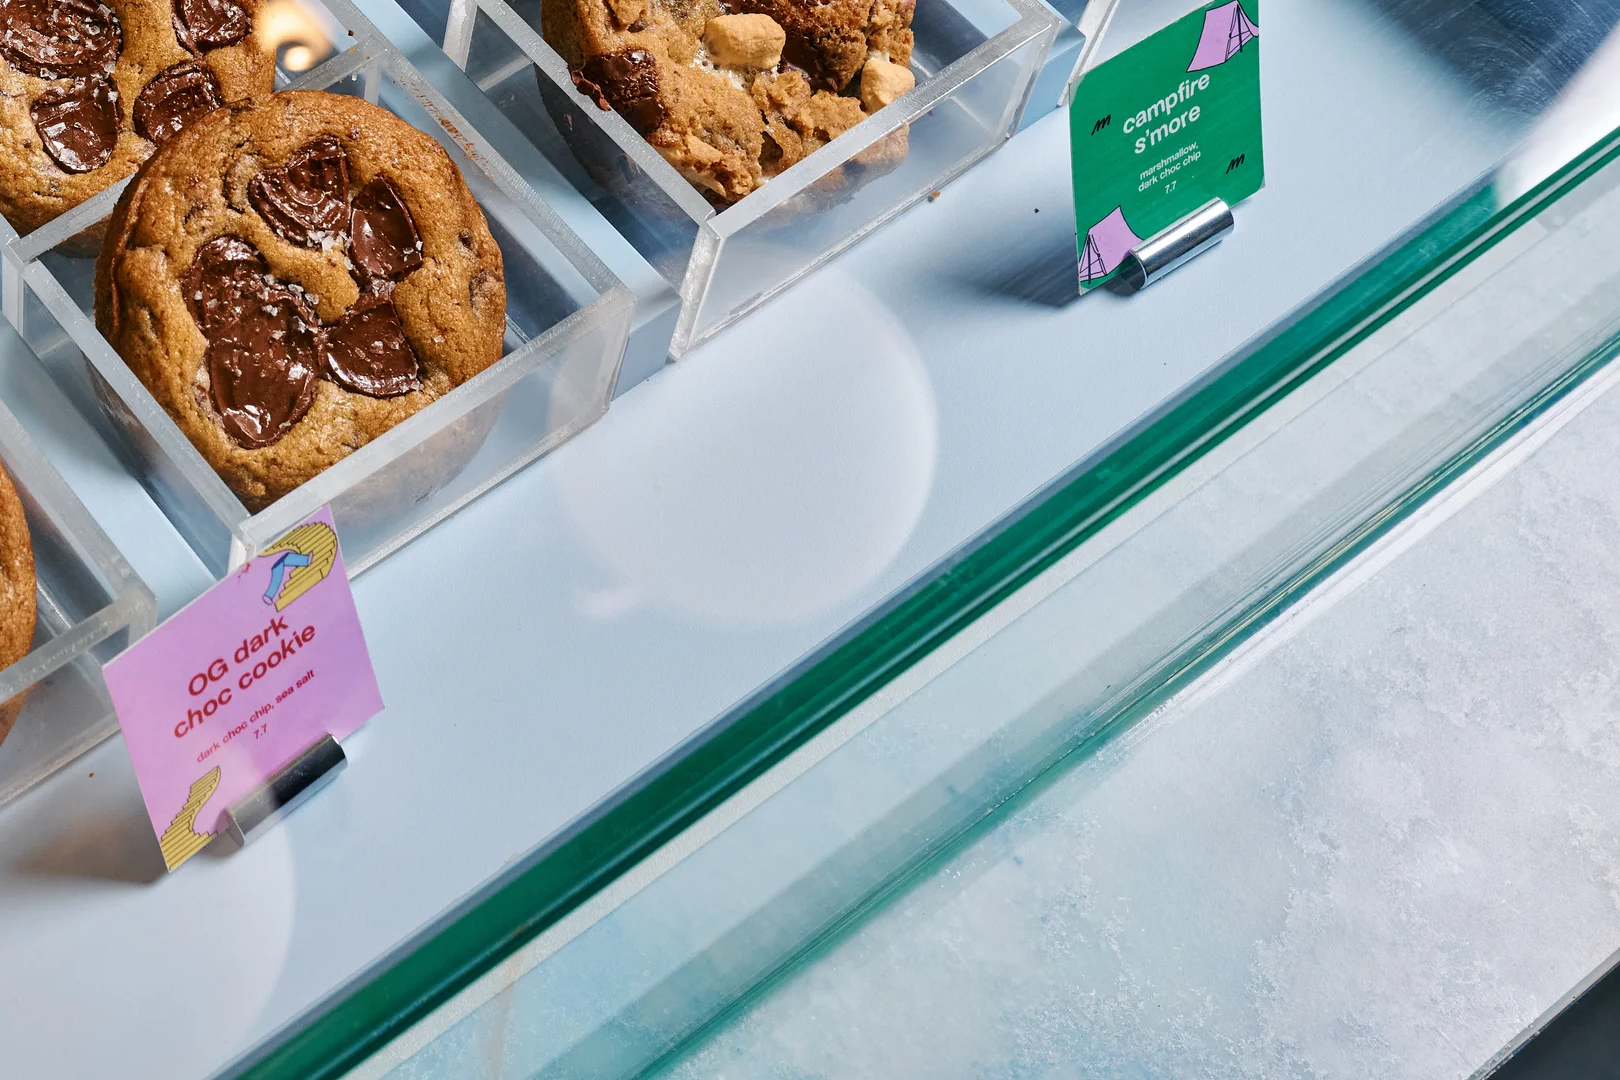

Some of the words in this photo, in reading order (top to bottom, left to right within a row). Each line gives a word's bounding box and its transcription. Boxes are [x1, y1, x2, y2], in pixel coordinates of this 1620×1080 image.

[1123, 73, 1210, 134] campfire
[1134, 105, 1201, 155] s'more
[1138, 176, 1158, 192] dark
[1160, 163, 1181, 180] choc
[1183, 151, 1201, 166] chip
[1140, 141, 1198, 180] marshmallow,
[1165, 180, 1177, 194] 7.7
[188, 657, 229, 696] OG
[234, 615, 289, 664] dark
[174, 688, 233, 738] choc
[239, 625, 316, 690] cookie
[196, 741, 221, 763] dark
[222, 721, 248, 744] choc
[249, 703, 275, 723] chip,
[275, 686, 294, 704] sea
[295, 669, 315, 688] salt
[253, 723, 268, 740] 7.7
